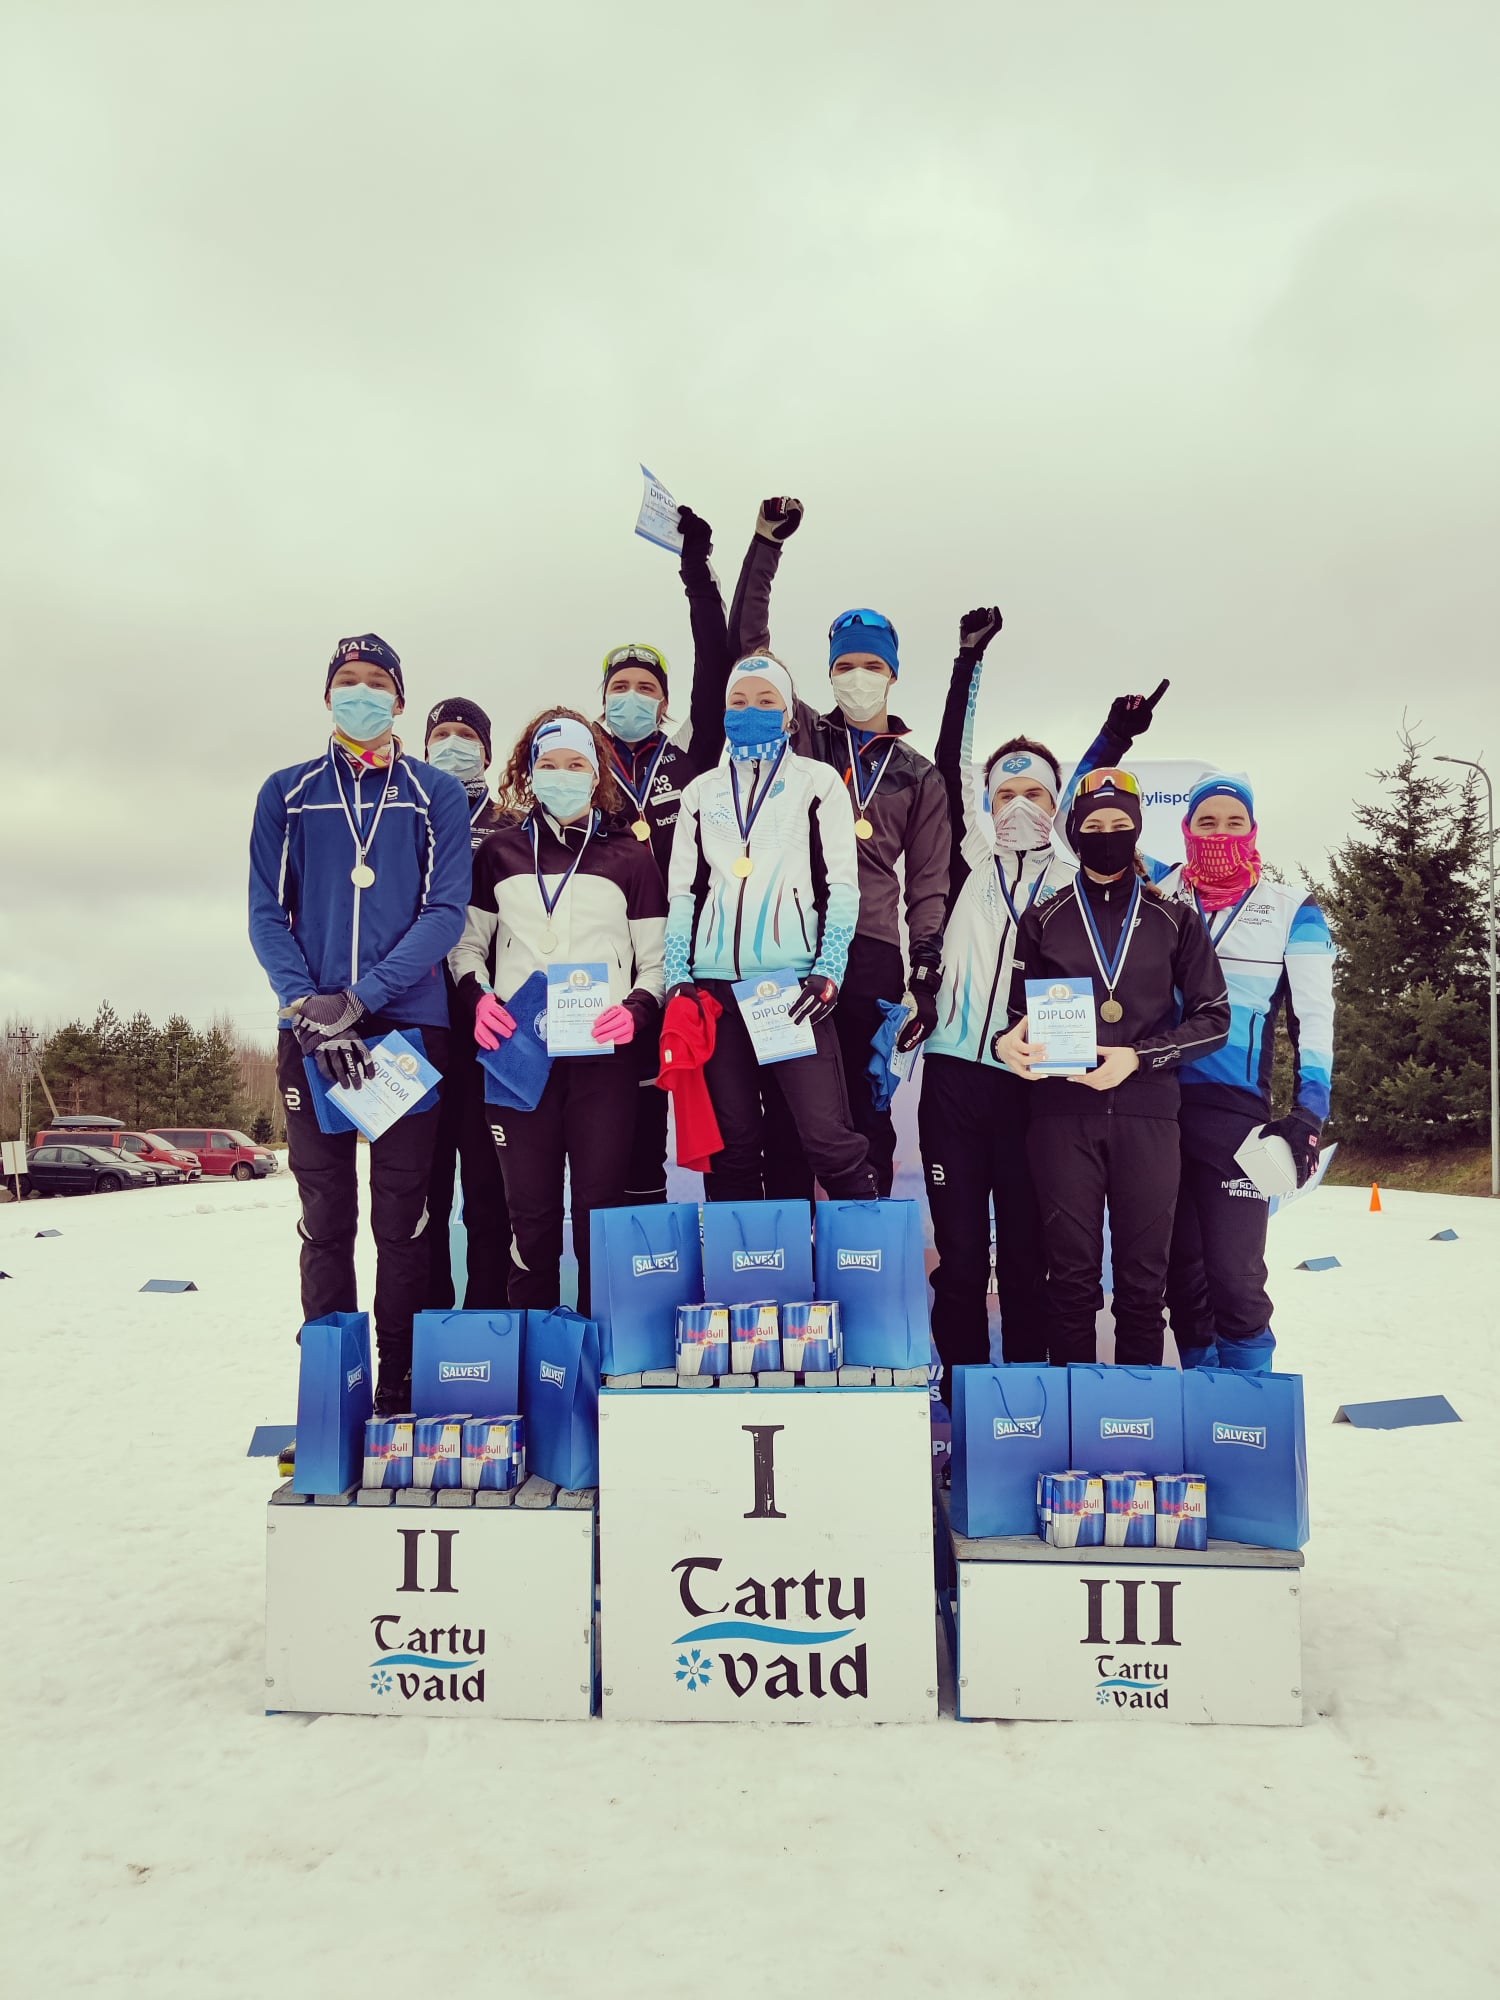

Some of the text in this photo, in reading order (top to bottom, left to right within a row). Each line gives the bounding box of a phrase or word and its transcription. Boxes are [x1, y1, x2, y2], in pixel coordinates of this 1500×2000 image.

[557, 997, 604, 1009] DIPLOM
[1037, 1009, 1086, 1020] DIPLOM
[344, 1052, 357, 1074] CRAFT
[373, 1061, 410, 1102] DIPLOM
[736, 1253, 780, 1268] SALVEST
[840, 1254, 877, 1267] SALVEST
[706, 1329, 724, 1338] Bull
[756, 1326, 774, 1336] Bull
[806, 1325, 823, 1335] Bull
[442, 1365, 487, 1378] SALVEST
[542, 1367, 564, 1384] SALVEST
[997, 1420, 1037, 1435] SALVEST
[1104, 1422, 1149, 1436] SALVEST
[1217, 1427, 1262, 1445] SALVEST
[390, 1442, 408, 1452] Bull
[438, 1444, 455, 1453] Bull
[485, 1444, 501, 1454] Bull
[742, 1425, 787, 1519] I
[1083, 1499, 1100, 1509] Bull
[1131, 1501, 1149, 1510] Bull
[1182, 1502, 1201, 1512] Bull
[396, 1528, 460, 1593] II
[671, 1557, 866, 1621] Tartu
[1079, 1579, 1182, 1646] III
[370, 1614, 486, 1655] Tartu
[718, 1643, 868, 1700] vald
[1095, 1654, 1168, 1681] Tartu
[397, 1669, 485, 1703] vald
[1112, 1688, 1169, 1710] vald
